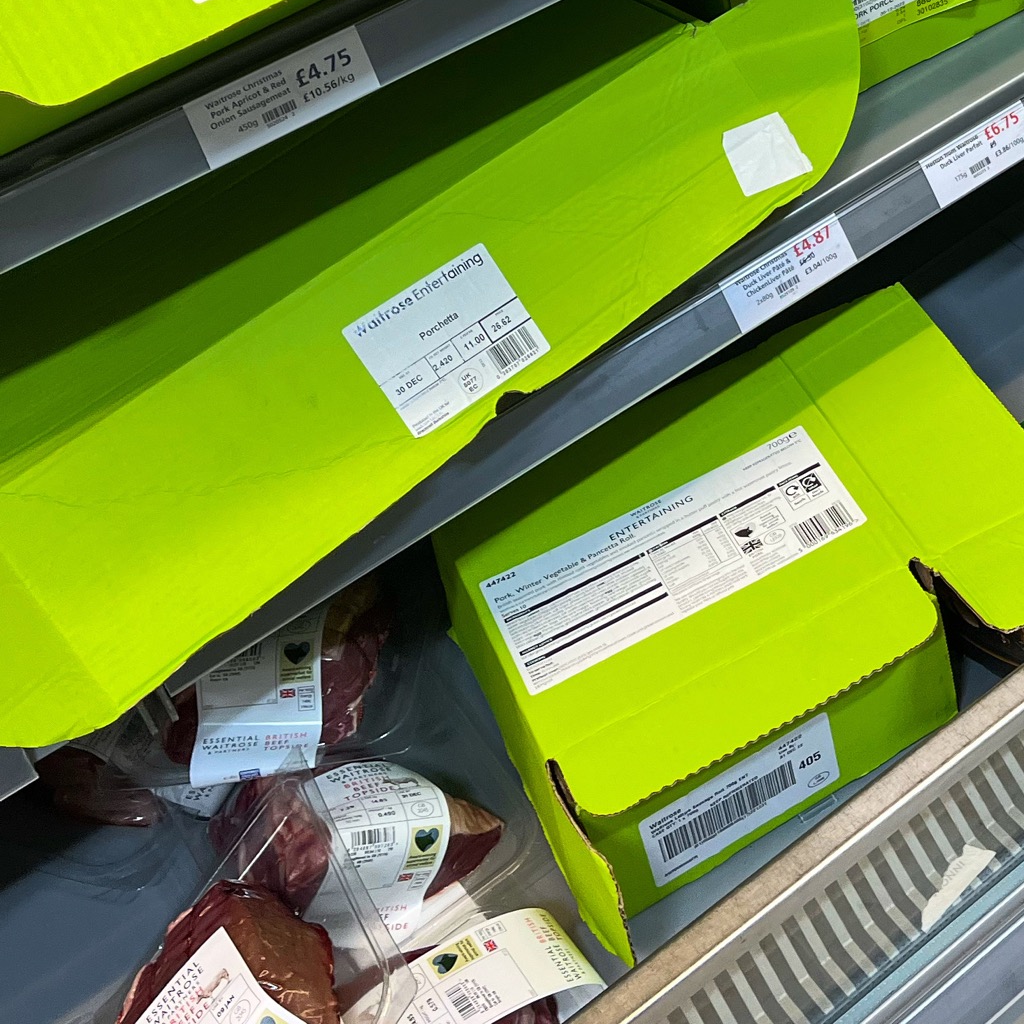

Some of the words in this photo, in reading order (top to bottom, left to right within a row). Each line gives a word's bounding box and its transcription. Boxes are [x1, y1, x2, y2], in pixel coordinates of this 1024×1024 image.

[296, 48, 352, 88] £4.75
[205, 89, 242, 110] Waitrose
[243, 69, 282, 92] Christmas
[211, 105, 230, 119] Pork
[232, 90, 262, 110] Apricot
[271, 77, 287, 90] Red
[210, 114, 236, 130] Onion
[238, 87, 291, 118] Sausagemeat
[238, 120, 258, 133] 450g
[303, 72, 355, 103] £10.56/kg
[984, 112, 1019, 140] £6.75
[956, 135, 978, 150] Waitrose
[995, 136, 1024, 157] £3.86/100g
[940, 159, 952, 169] Duck
[953, 151, 965, 162] Liver
[966, 141, 983, 153] Parfait
[792, 225, 831, 257] £4.87
[734, 269, 760, 286] Waitrose
[760, 251, 788, 271] Christmas
[743, 280, 757, 291] Duck
[758, 271, 771, 283] Liver
[772, 262, 786, 274] Pâté
[756, 292, 774, 305] 2x80g
[805, 252, 838, 275] £3.04/100g
[782, 265, 795, 277] Pâté
[354, 297, 413, 338] Waitrose
[412, 253, 484, 301] Entertaining
[419, 311, 459, 341] Porchetta
[491, 315, 512, 333] 26.62
[464, 333, 485, 351] 11.00
[432, 354, 453, 372] 2.420
[395, 387, 406, 396] 30
[406, 374, 423, 389] DEC
[460, 372, 472, 382] UK
[469, 384, 478, 392] EC
[609, 495, 694, 541] ENTERTAINING
[630, 499, 662, 517] WAITROSE
[486, 571, 516, 588] 447422
[494, 593, 515, 603] Pork,
[515, 579, 542, 593] Winter
[543, 560, 579, 581] Vegetable
[587, 542, 619, 560] Pancetta
[202, 741, 259, 750] WAITROSE
[203, 735, 260, 744] ESSENTIAL
[265, 732, 308, 740] BRITISH
[326, 762, 386, 780] ESSENTIAL
[799, 751, 821, 769] 405
[330, 766, 392, 784] WAITROSE
[345, 786, 396, 801] TOPSIDE
[354, 783, 379, 792] BEEF
[649, 808, 681, 829] Waitrose
[524, 916, 545, 943] BRITISH
[540, 926, 553, 942] BEEF
[544, 946, 574, 983] ESSENTIAL
[554, 944, 582, 980] WAITROSE
[146, 962, 200, 1023] ESSENTIAL
